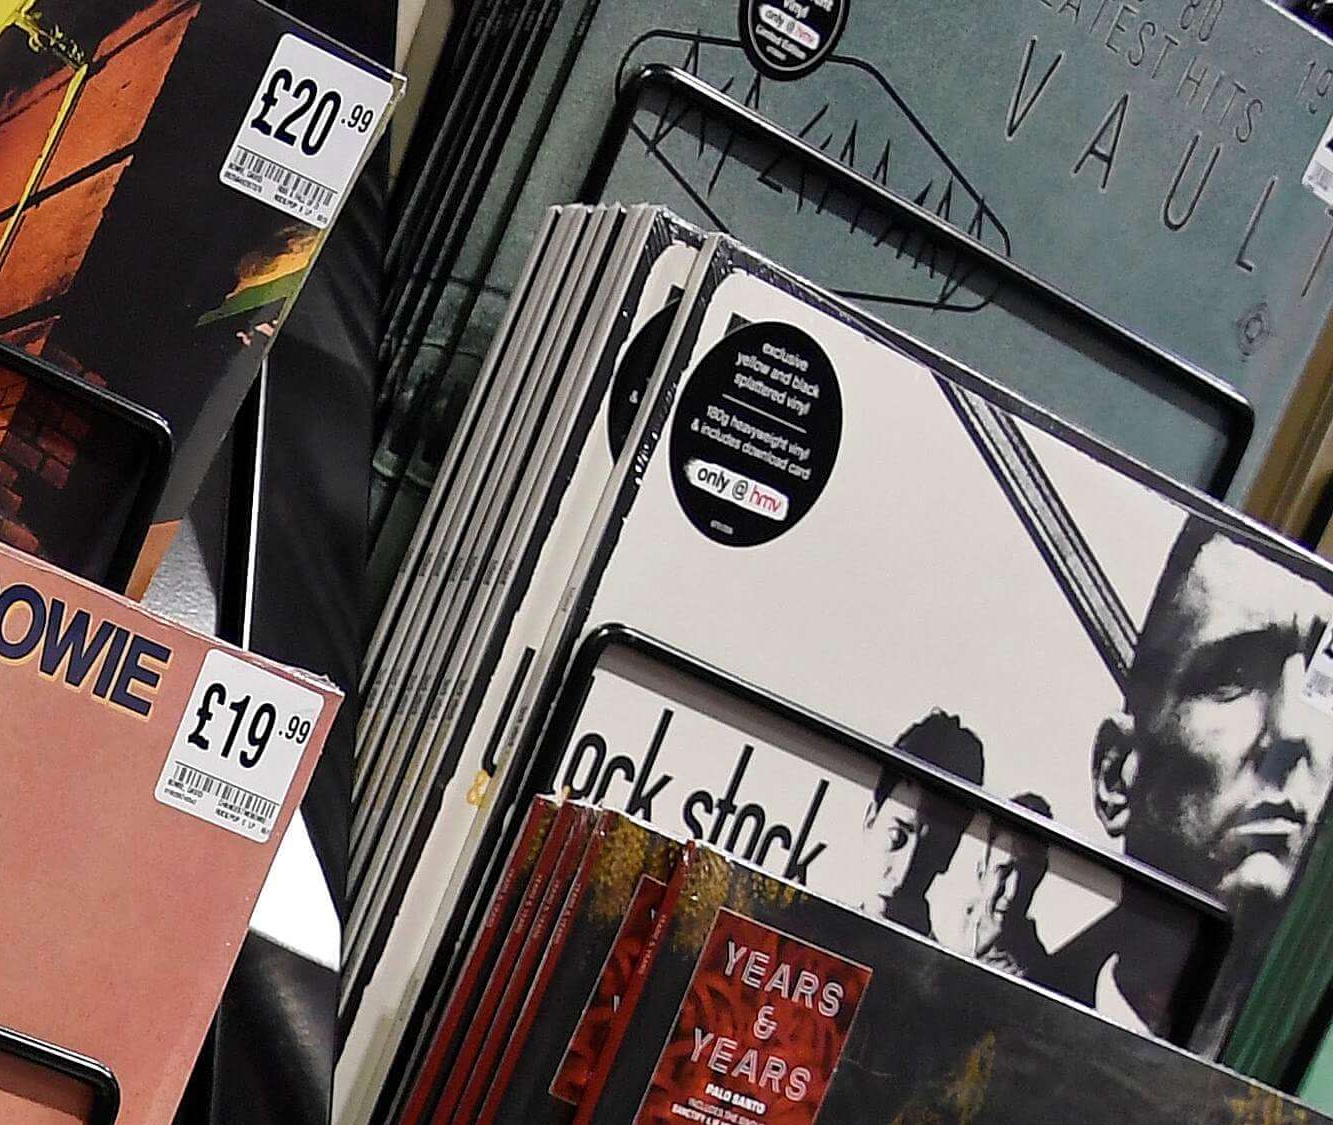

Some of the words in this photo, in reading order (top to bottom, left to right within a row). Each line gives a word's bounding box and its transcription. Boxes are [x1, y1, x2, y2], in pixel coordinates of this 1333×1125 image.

[251, 68, 374, 156] £20.99
[1175, 56, 1264, 143] HITS
[735, 351, 772, 376] yellow
[770, 367, 793, 386] and
[791, 374, 821, 399] black
[762, 342, 810, 372] exclusive
[734, 373, 788, 405] splattered
[787, 395, 812, 417] vinyl
[691, 417, 700, 432] &
[700, 421, 742, 450] includes
[741, 442, 790, 471] download
[788, 462, 813, 481] card
[730, 414, 789, 451] heavyweight
[788, 442, 812, 462] vinyl
[697, 467, 730, 494] only
[732, 479, 749, 501] @
[748, 484, 782, 513] hmv
[187, 682, 311, 768] £19.99
[562, 708, 674, 822] ock
[724, 940, 845, 1018] YEARS
[753, 1005, 778, 1040] &
[689, 1026, 812, 1102] YEARS
